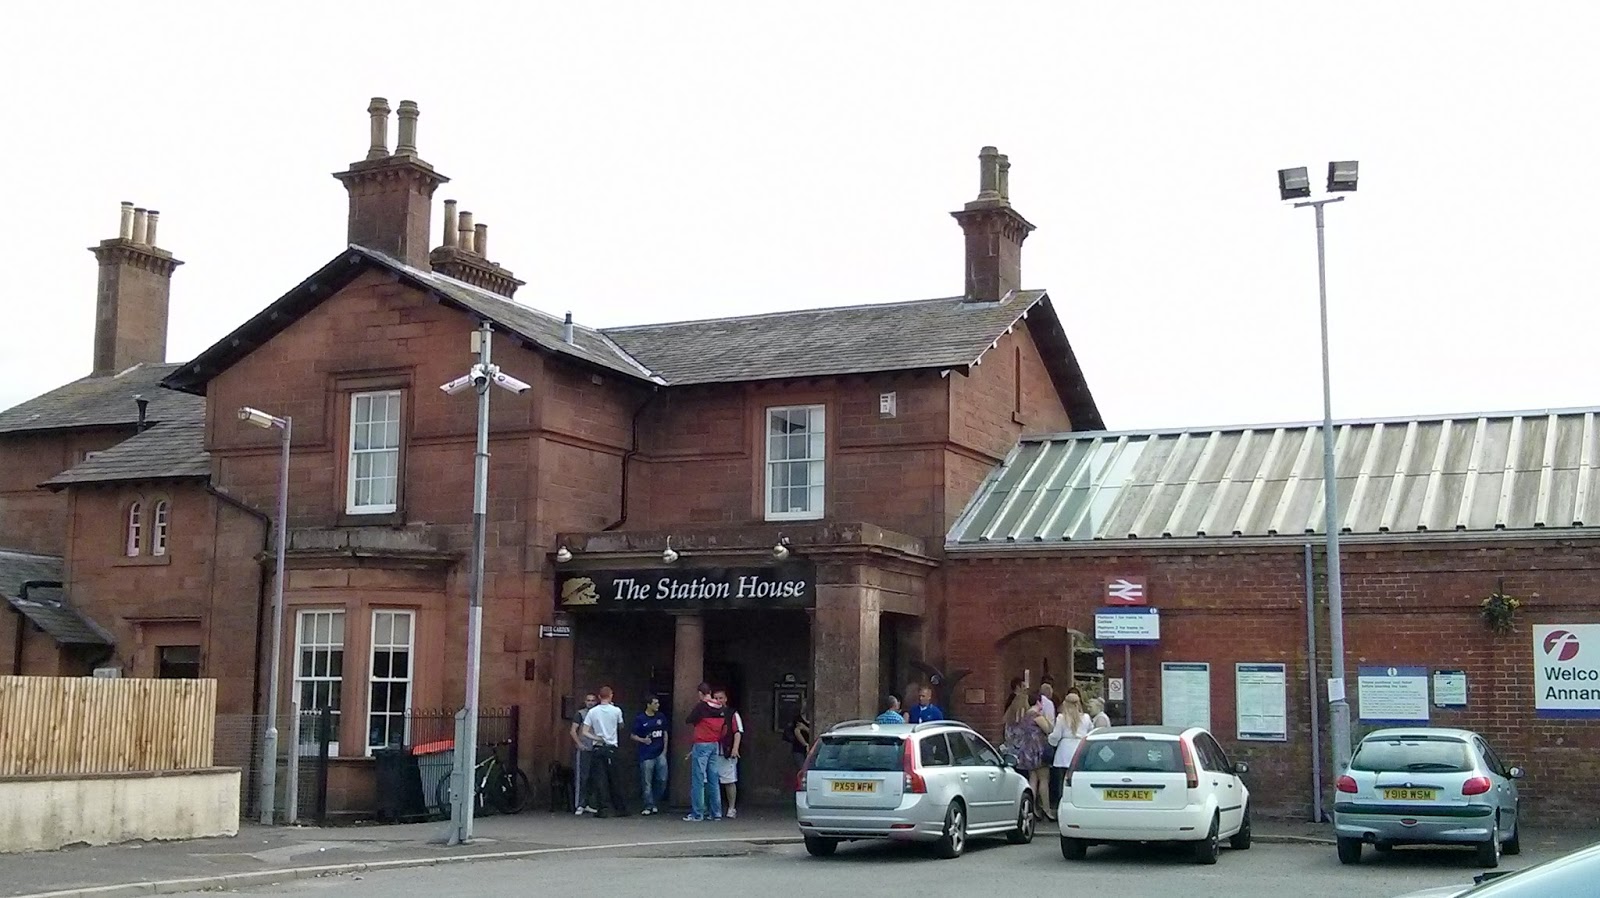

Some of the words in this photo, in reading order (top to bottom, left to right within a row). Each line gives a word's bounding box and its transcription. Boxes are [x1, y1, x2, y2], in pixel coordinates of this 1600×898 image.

[612, 577, 651, 600] The
[655, 576, 730, 600] Station
[735, 575, 806, 598] House
[1544, 666, 1599, 681] Welco
[1545, 685, 1600, 700] Annan
[834, 782, 855, 791] PX59
[1132, 790, 1149, 799] AEY
[1384, 789, 1408, 799] Y918
[1410, 790, 1431, 800] WSM
